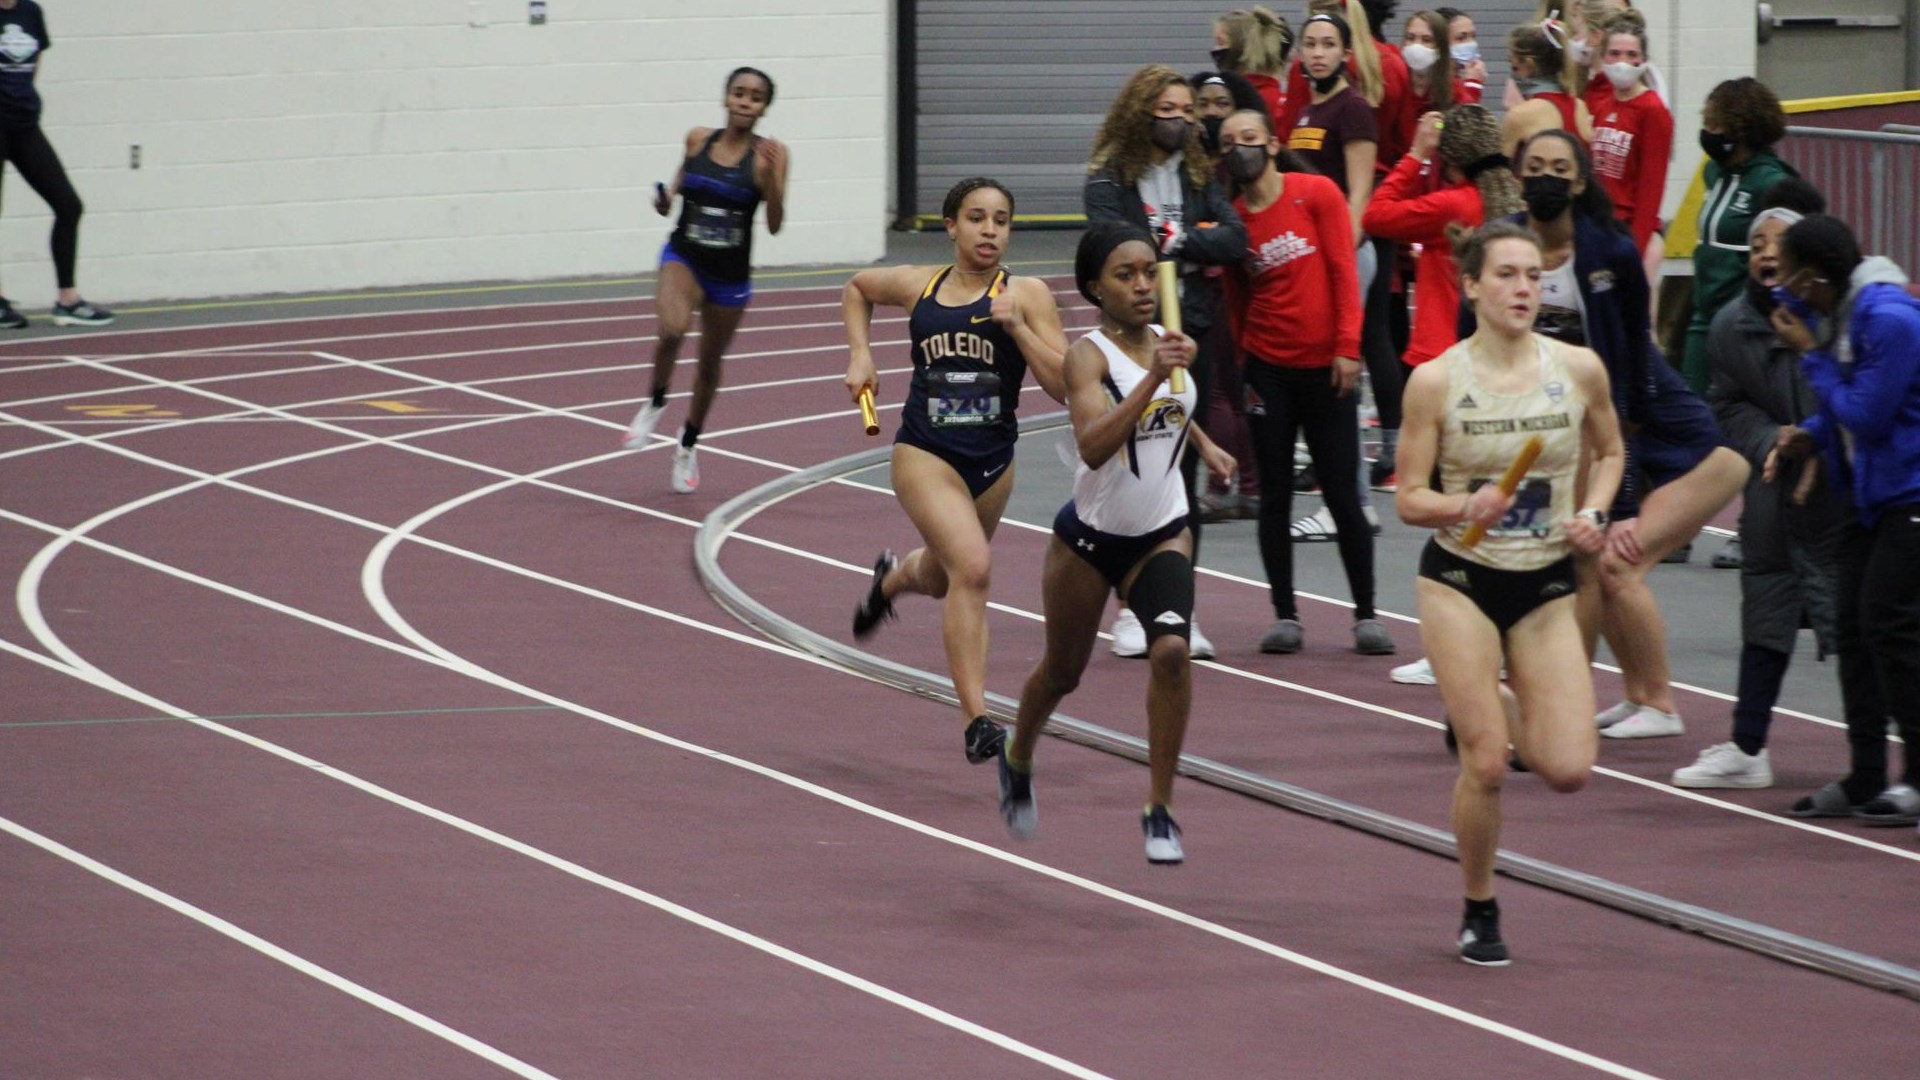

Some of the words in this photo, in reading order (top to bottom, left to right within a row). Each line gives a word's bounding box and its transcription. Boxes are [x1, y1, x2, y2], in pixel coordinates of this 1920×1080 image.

[920, 331, 994, 365] TOLEDO
[1462, 418, 1515, 436] WESTERN
[1519, 412, 1570, 432] MICHIGAN
